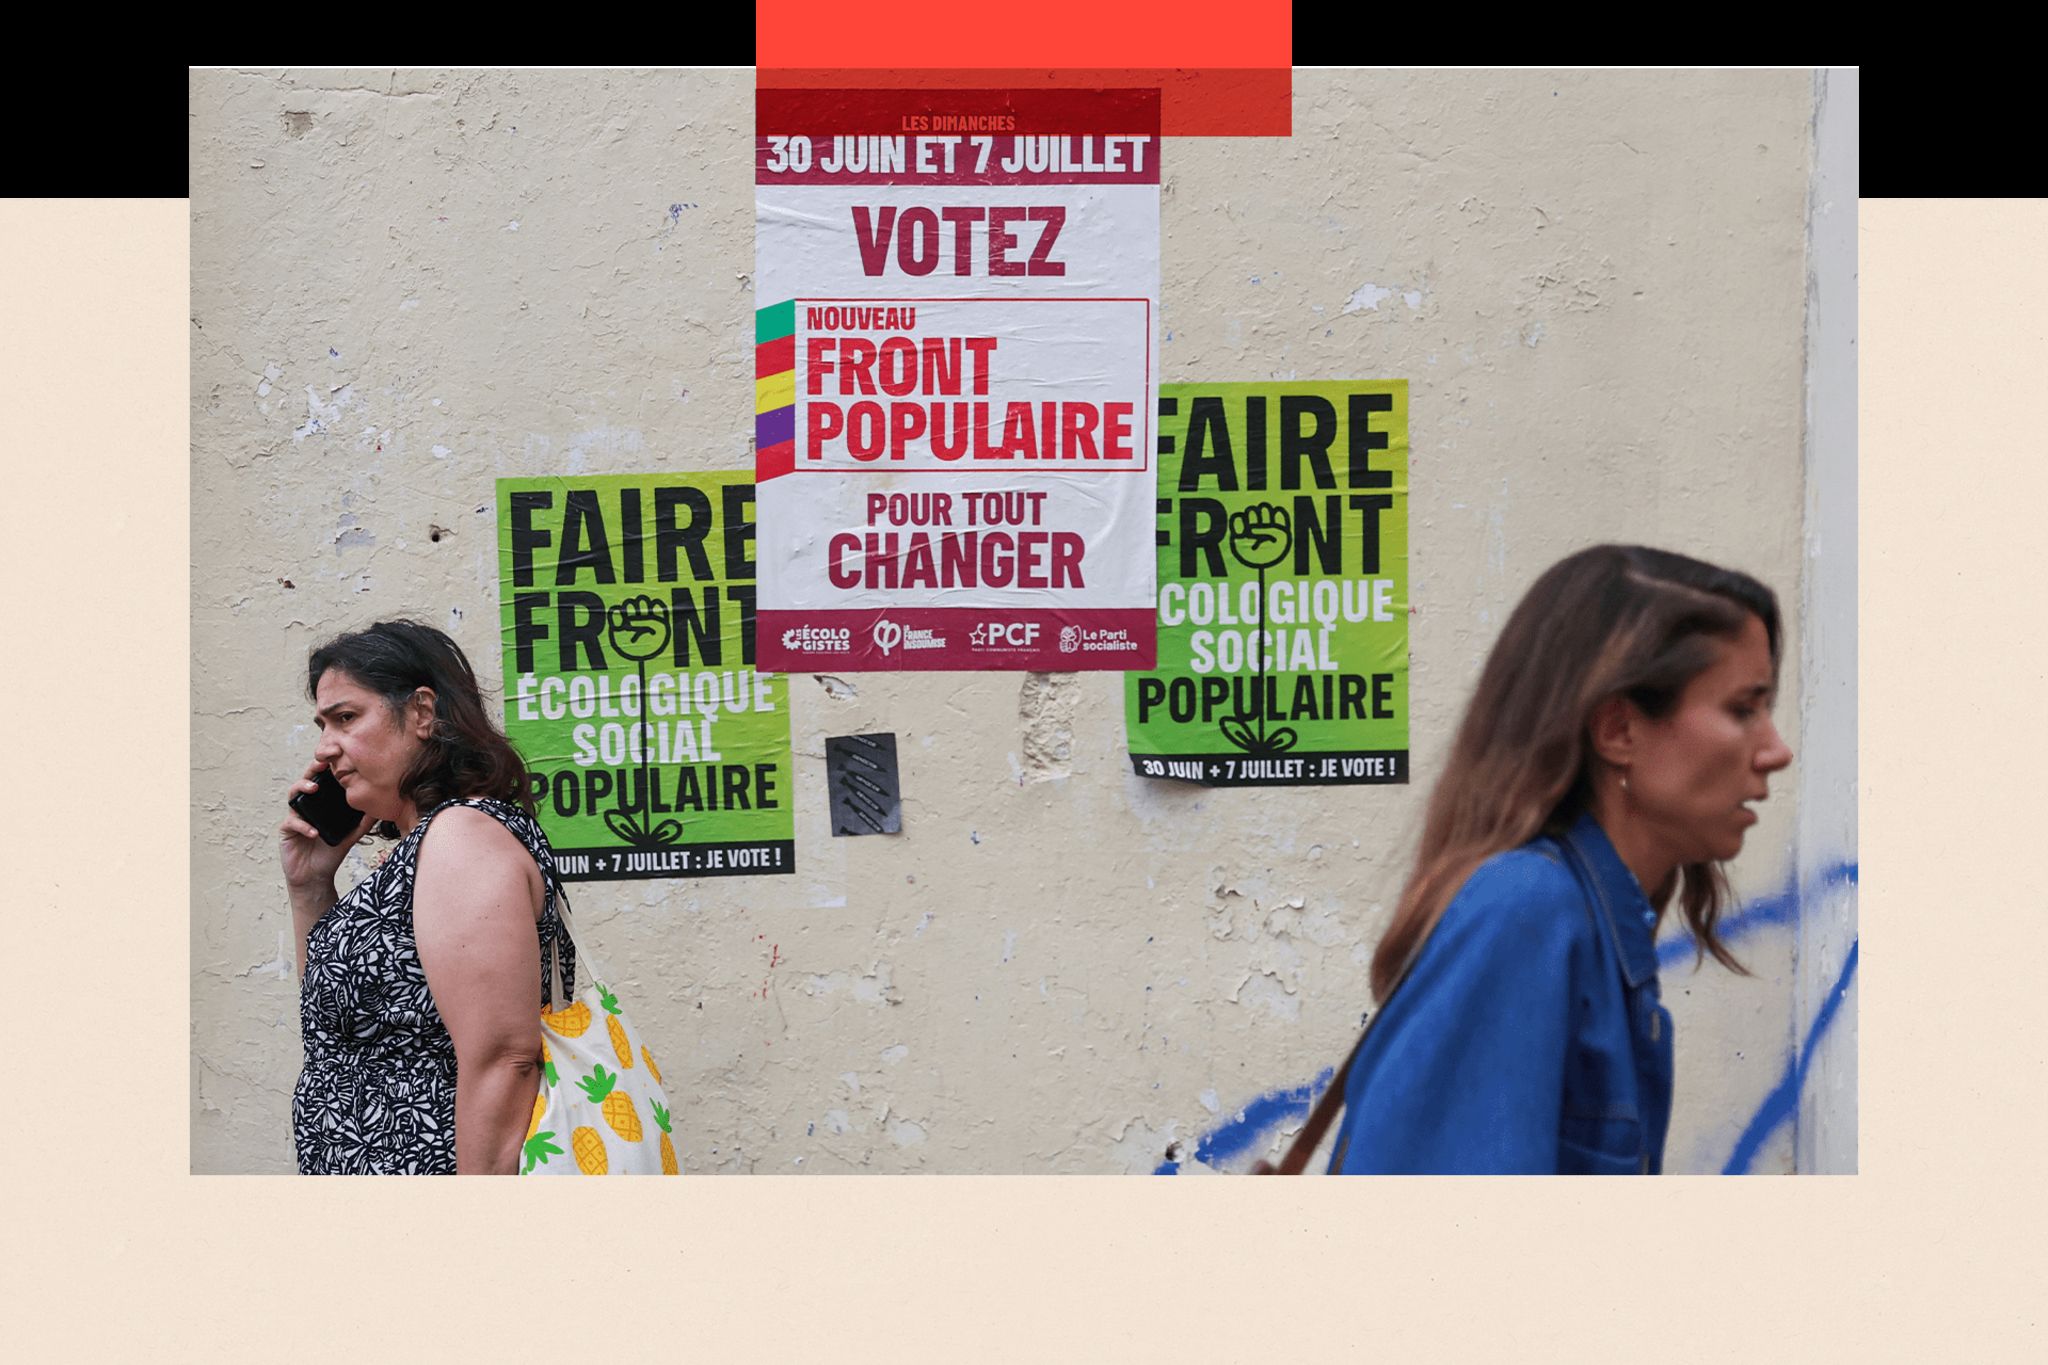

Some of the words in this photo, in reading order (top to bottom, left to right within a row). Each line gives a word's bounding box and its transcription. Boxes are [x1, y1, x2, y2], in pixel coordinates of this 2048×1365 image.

[902, 115, 929, 132] LES
[932, 115, 1016, 132] DIMANCHES
[766, 136, 812, 173] 30
[820, 136, 905, 174] JUIN
[915, 136, 962, 174] ET
[970, 136, 994, 174] 7
[1001, 136, 1151, 173] JUILLET
[850, 206, 1066, 277] VOTEZ
[807, 307, 916, 331] NOUVEAU
[807, 336, 998, 396] FRONT
[807, 401, 1133, 462] POPULAIRE
[867, 492, 952, 526] POUR
[962, 491, 1047, 526] TOUT
[510, 484, 756, 587] FAIRE
[828, 531, 1086, 590] CHANGER
[1159, 579, 1394, 631] COLOGIQUE
[802, 624, 851, 640] ÉCOLO
[802, 640, 850, 650] GISTES
[988, 623, 1040, 646] PCF
[1082, 629, 1096, 640] Le
[1100, 629, 1127, 640] Parti
[1082, 640, 1138, 651] socialiste
[1190, 628, 1339, 673] SOCIAL
[517, 671, 776, 723] ÉCOLOGIQUE
[1138, 673, 1394, 724] POPULAIRE
[572, 720, 722, 767] SOCIAL
[1142, 759, 1165, 777] 30
[1168, 760, 1204, 780] JUIN
[1225, 761, 1236, 780] 7
[1240, 759, 1304, 780] JUILLET
[1319, 758, 1338, 778] JE
[1341, 757, 1385, 778] VOTE
[611, 854, 623, 873] 7
[626, 851, 691, 872] JUILLET
[706, 849, 723, 869] JE
[727, 848, 771, 868] VOTE
